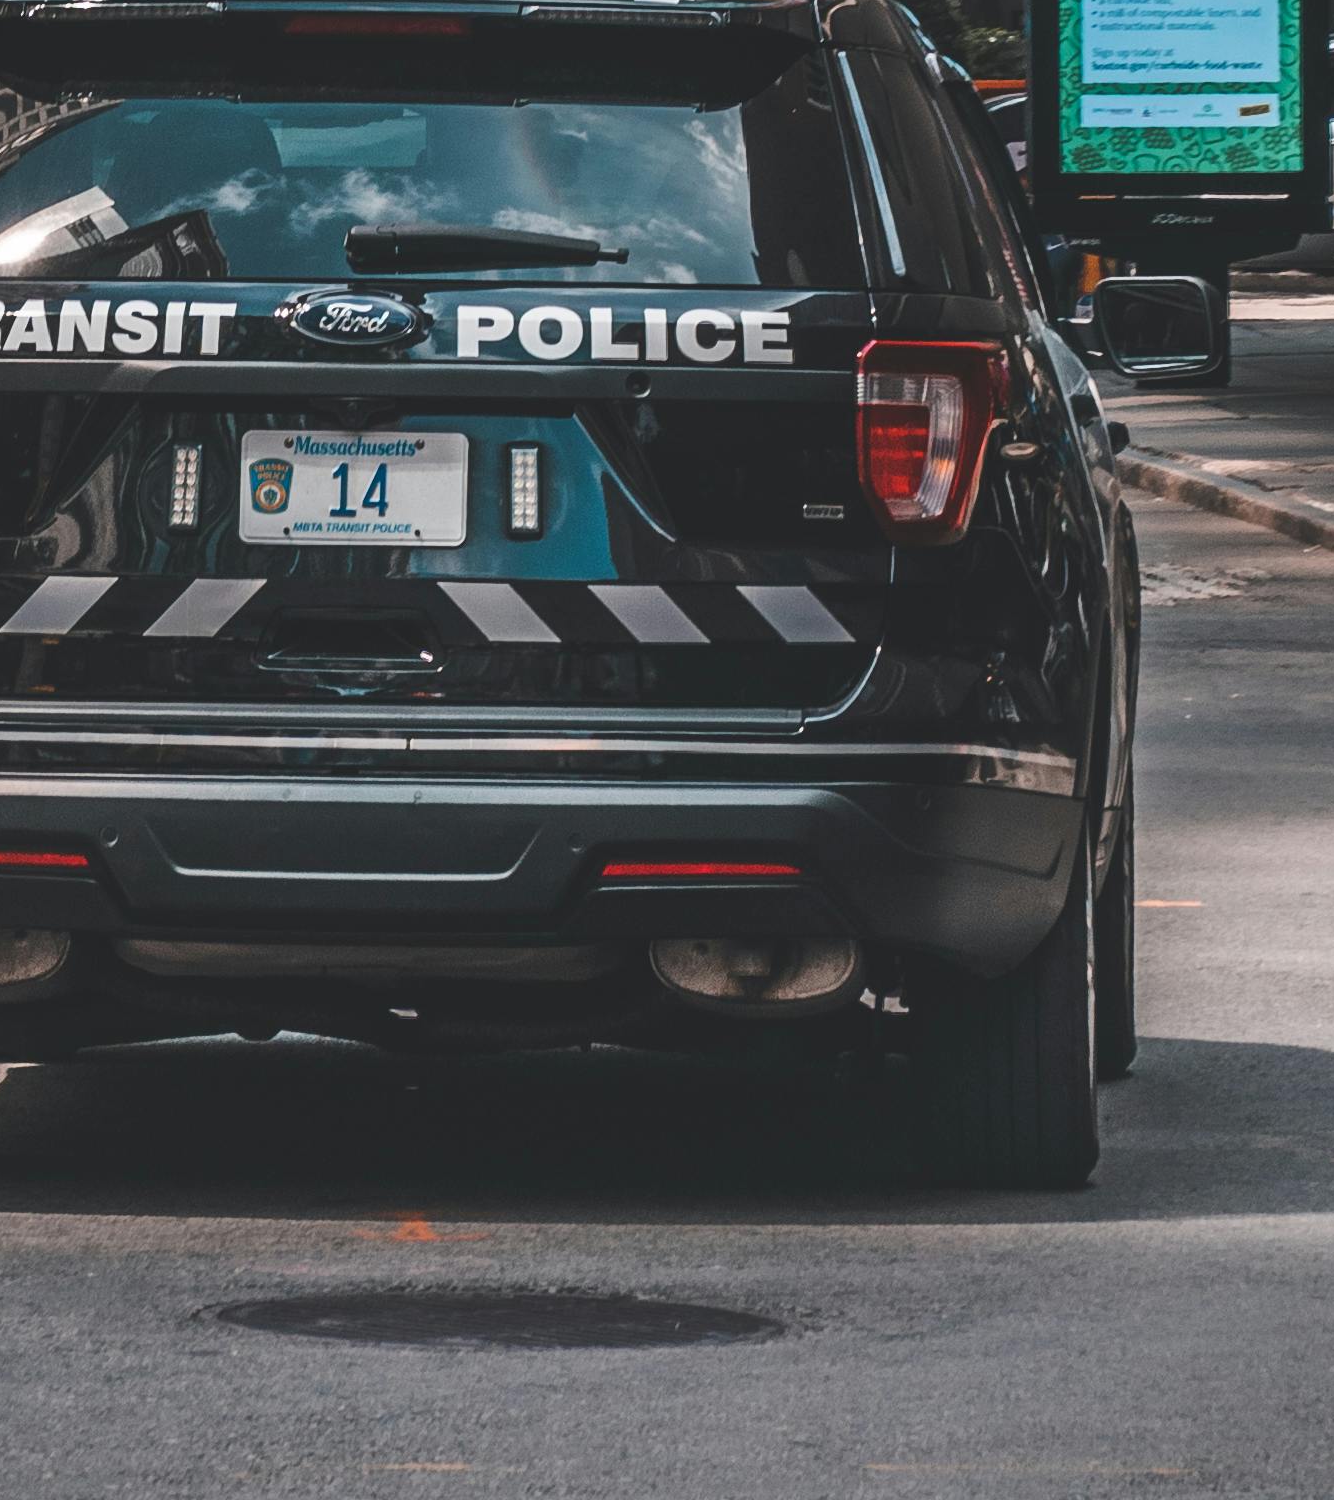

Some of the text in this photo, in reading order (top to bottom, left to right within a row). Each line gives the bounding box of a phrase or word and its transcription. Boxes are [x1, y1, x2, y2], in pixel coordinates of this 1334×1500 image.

[319, 303, 390, 333] Ford
[456, 304, 794, 364] POLICE
[294, 436, 417, 457] Massachusetts
[329, 462, 389, 518] 14
[293, 522, 412, 533] MBTA TRANSIT POLICE
